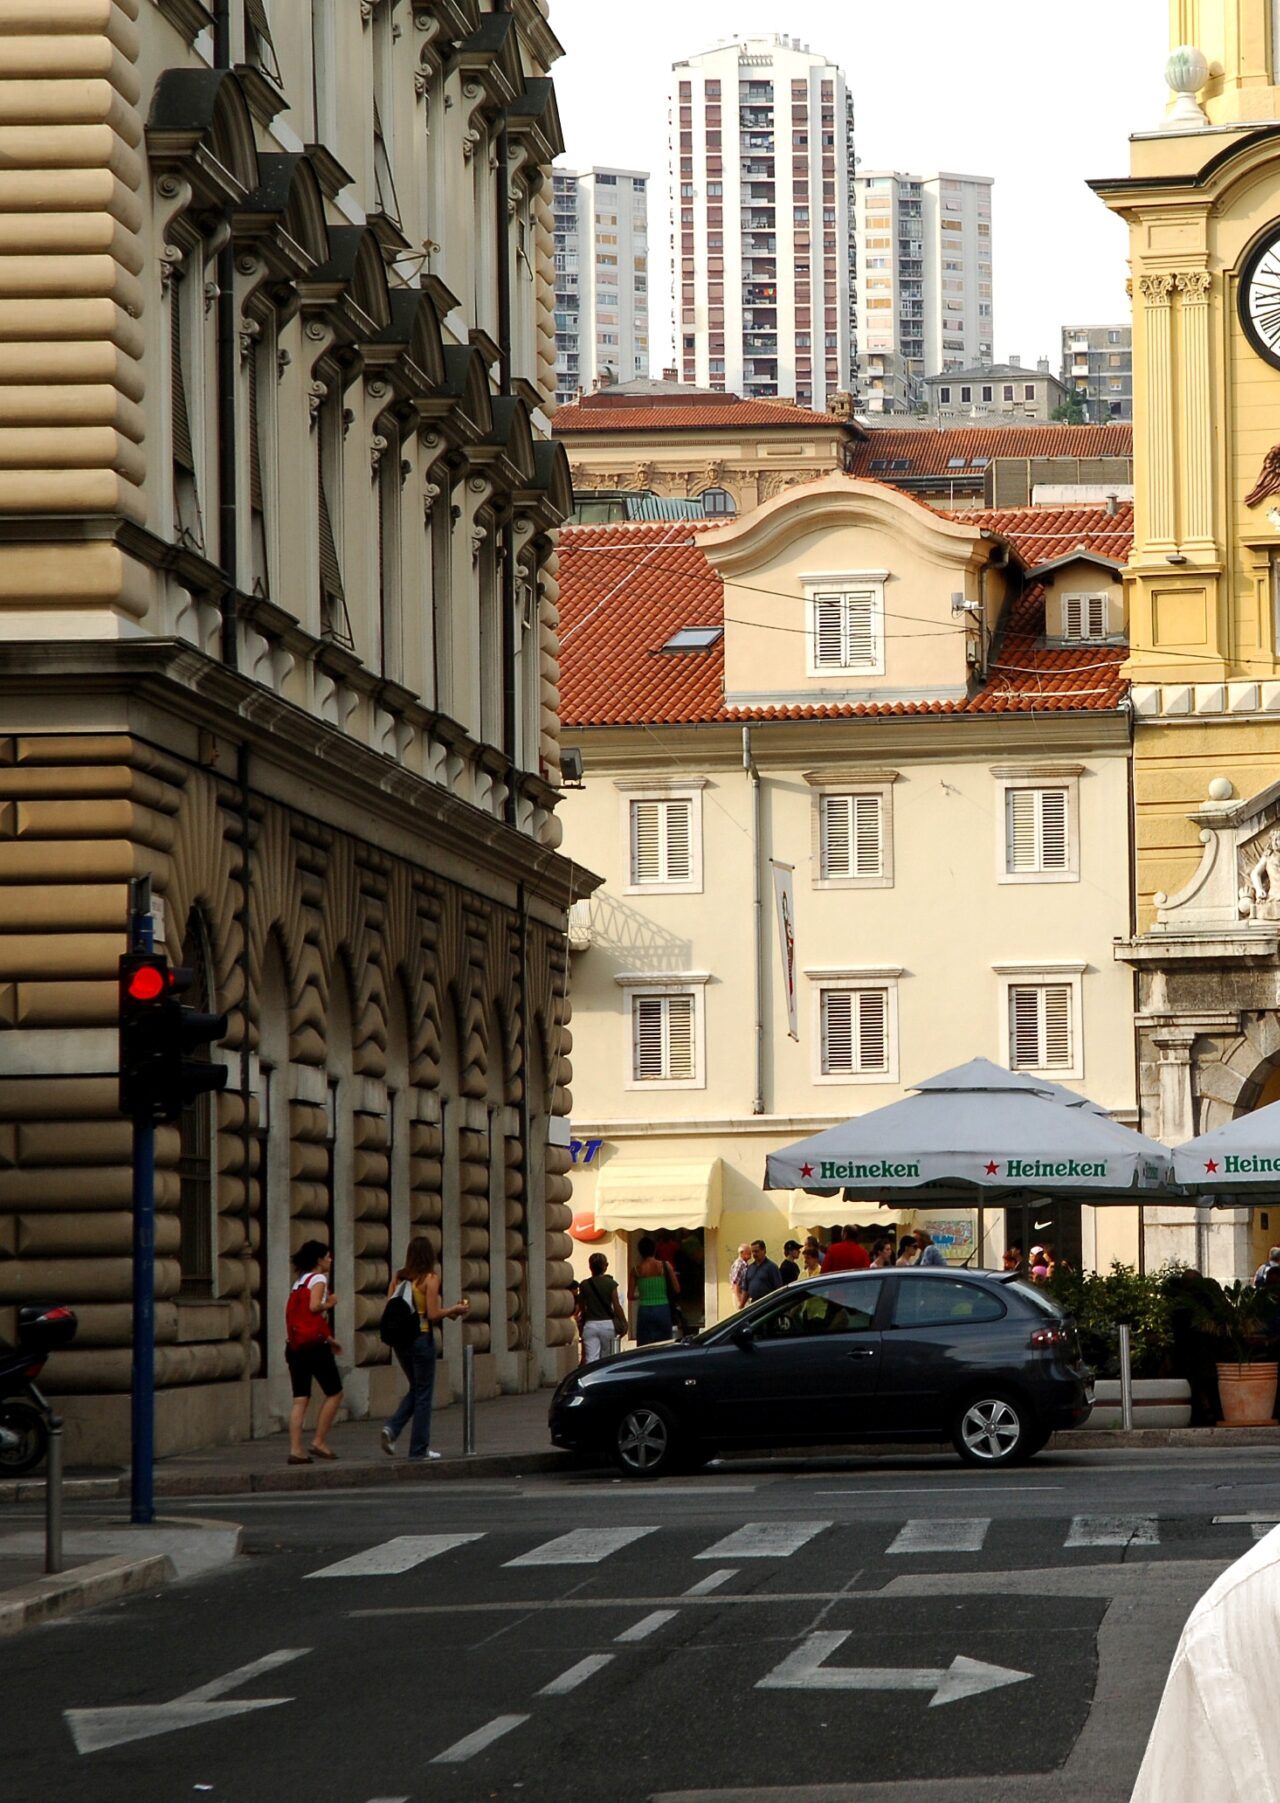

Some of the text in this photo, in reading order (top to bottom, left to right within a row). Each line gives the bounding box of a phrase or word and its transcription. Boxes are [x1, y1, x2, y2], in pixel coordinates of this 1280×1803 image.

[1255, 291, 1280, 309] IX
[820, 1160, 920, 1179] Heineken
[1006, 1159, 1106, 1177] Heineken
